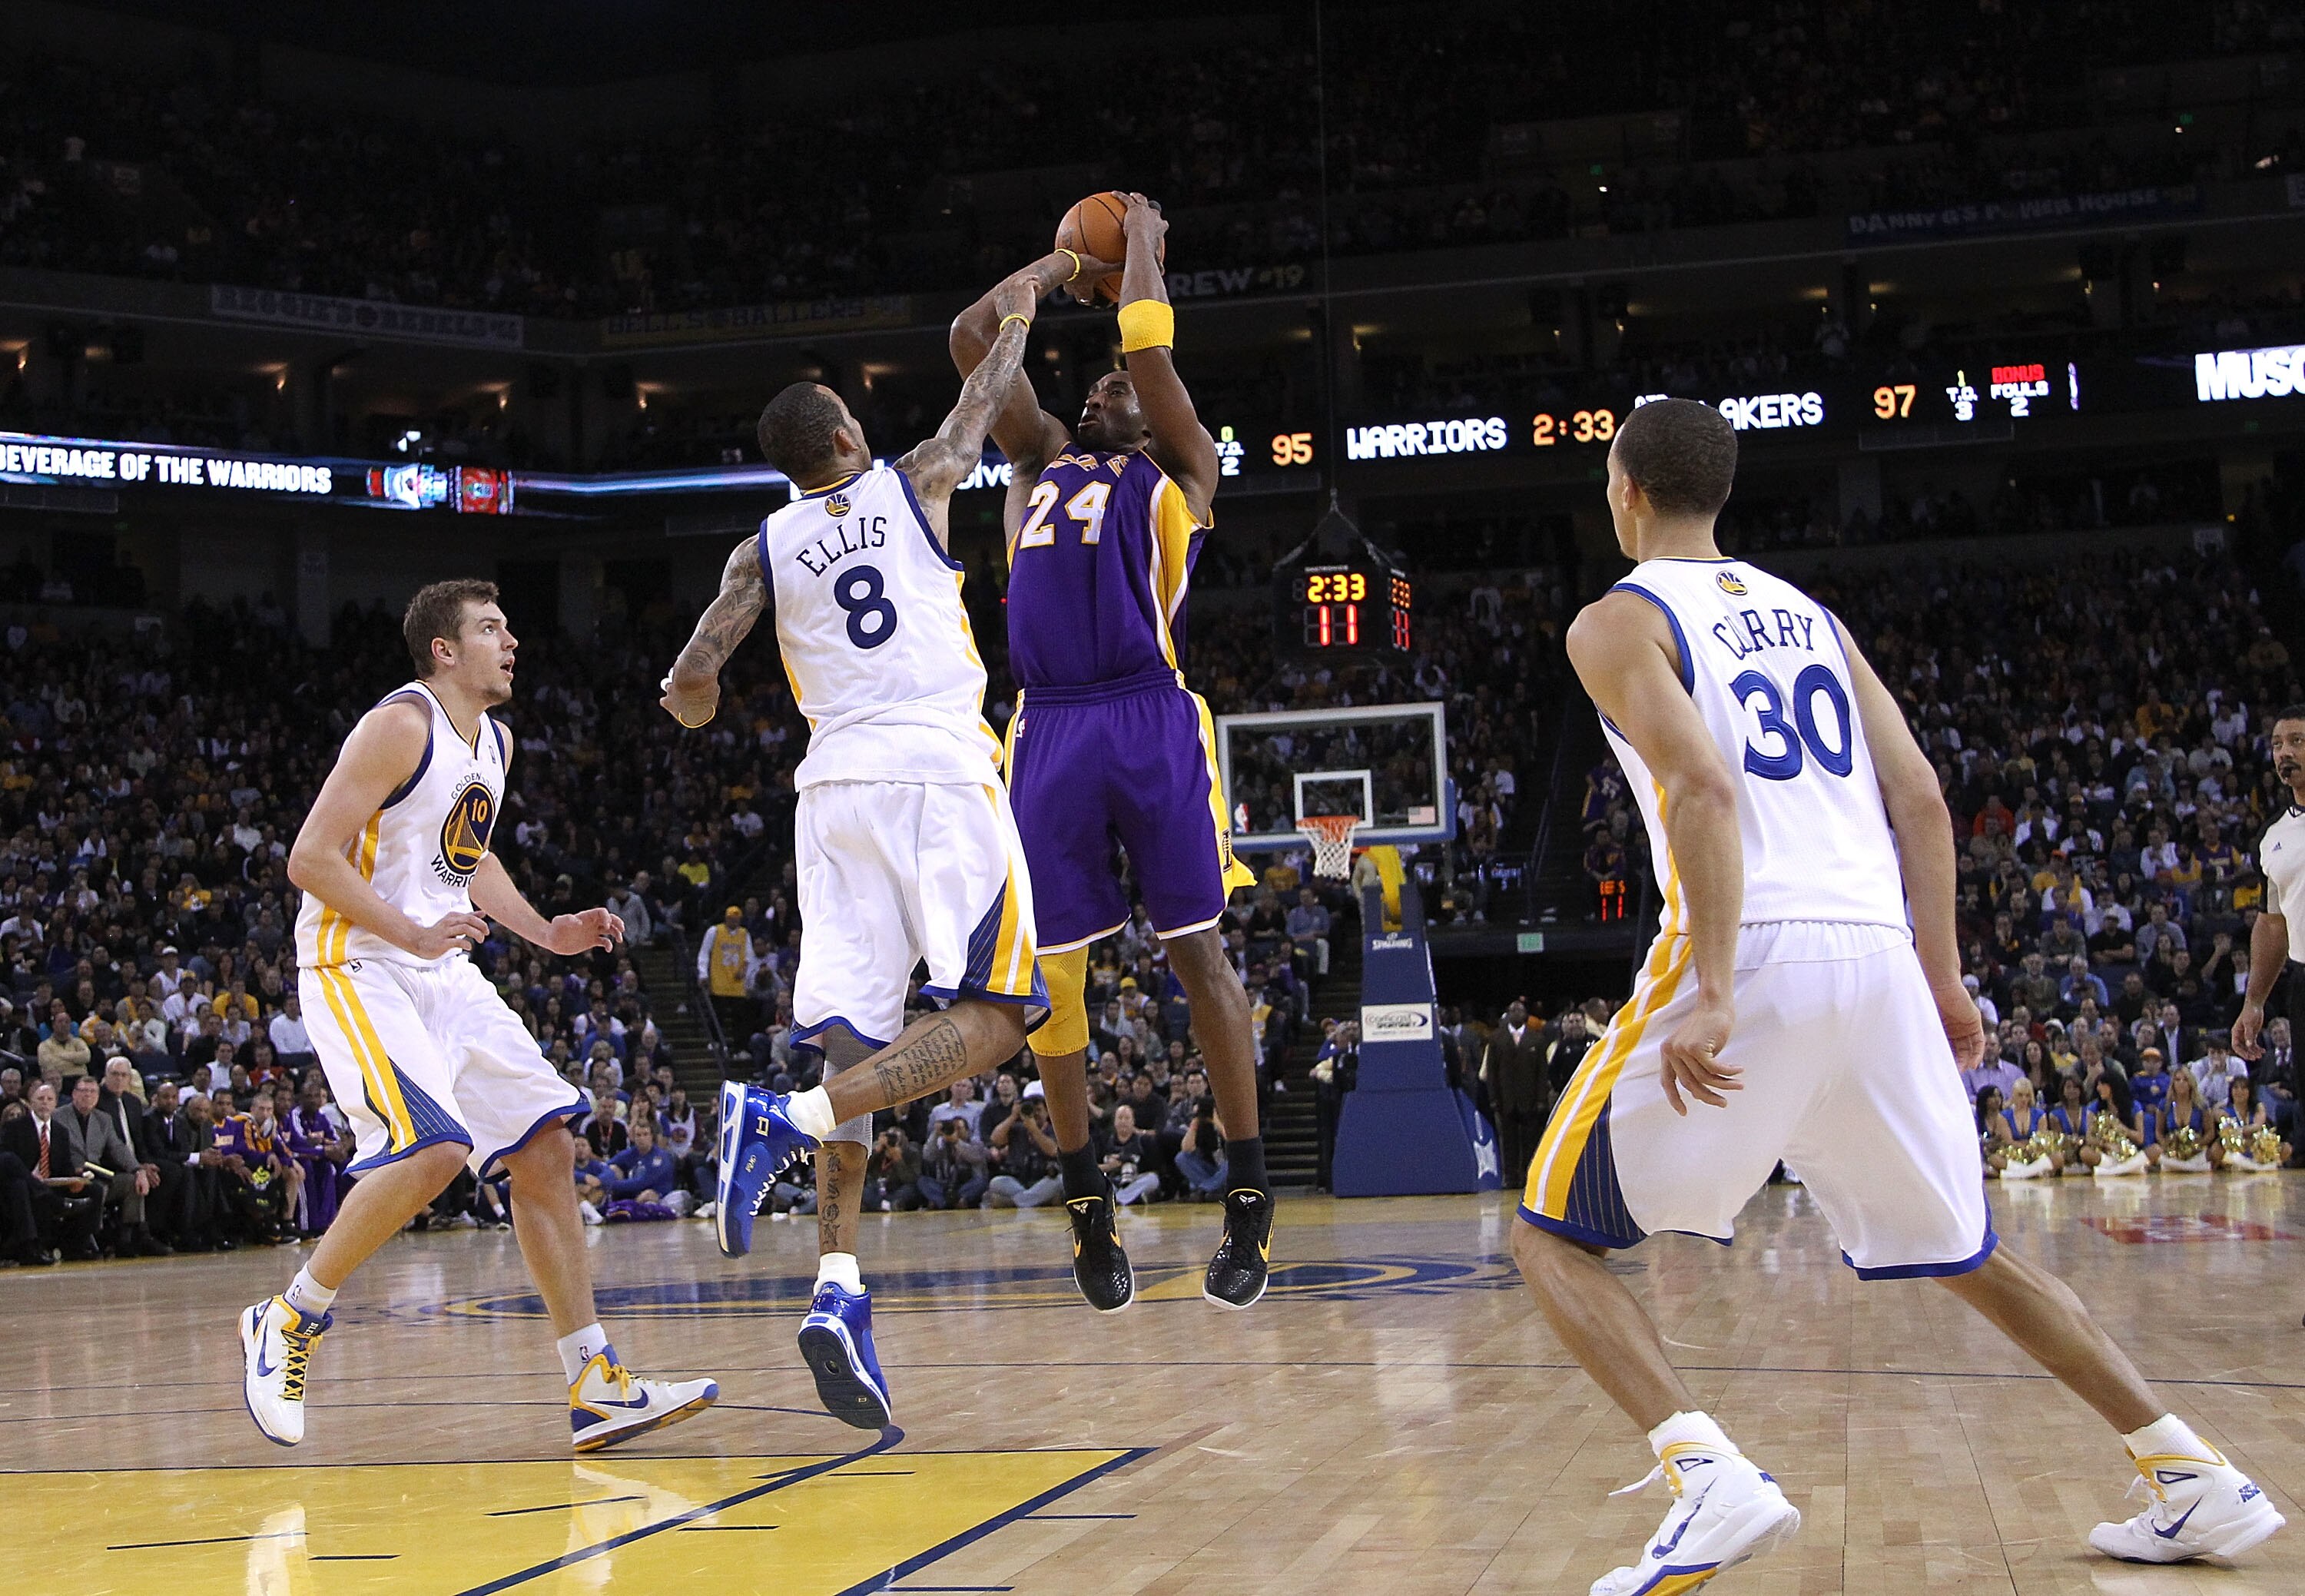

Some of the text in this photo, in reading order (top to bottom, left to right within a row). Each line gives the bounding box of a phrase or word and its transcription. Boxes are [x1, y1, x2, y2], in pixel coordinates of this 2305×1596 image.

[1849, 211, 1936, 234] DANNY
[2077, 187, 2158, 212] HOUSE
[1991, 363, 2045, 384] BONUS
[1272, 433, 1313, 466] 95
[1345, 417, 1507, 460] WARRIORS
[1532, 409, 1615, 446] 2:33
[1700, 392, 1823, 430] AKERS
[1873, 384, 1917, 420] 97
[1955, 400, 1974, 421] 3
[2010, 397, 2029, 417] 2
[120, 453, 152, 482] OF
[154, 456, 204, 485] THE
[207, 460, 332, 494] WARRIORS
[1221, 456, 1240, 476] 2
[1020, 479, 1112, 550] 24
[796, 516, 887, 577] ELLIS
[834, 565, 897, 650] 8
[1307, 572, 1367, 603] 2:33
[1318, 604, 1359, 646] 11
[1713, 609, 1814, 661] CURRY
[1727, 664, 1853, 781] 30
[451, 772, 482, 800] GOLDEN
[471, 798, 489, 823] 10
